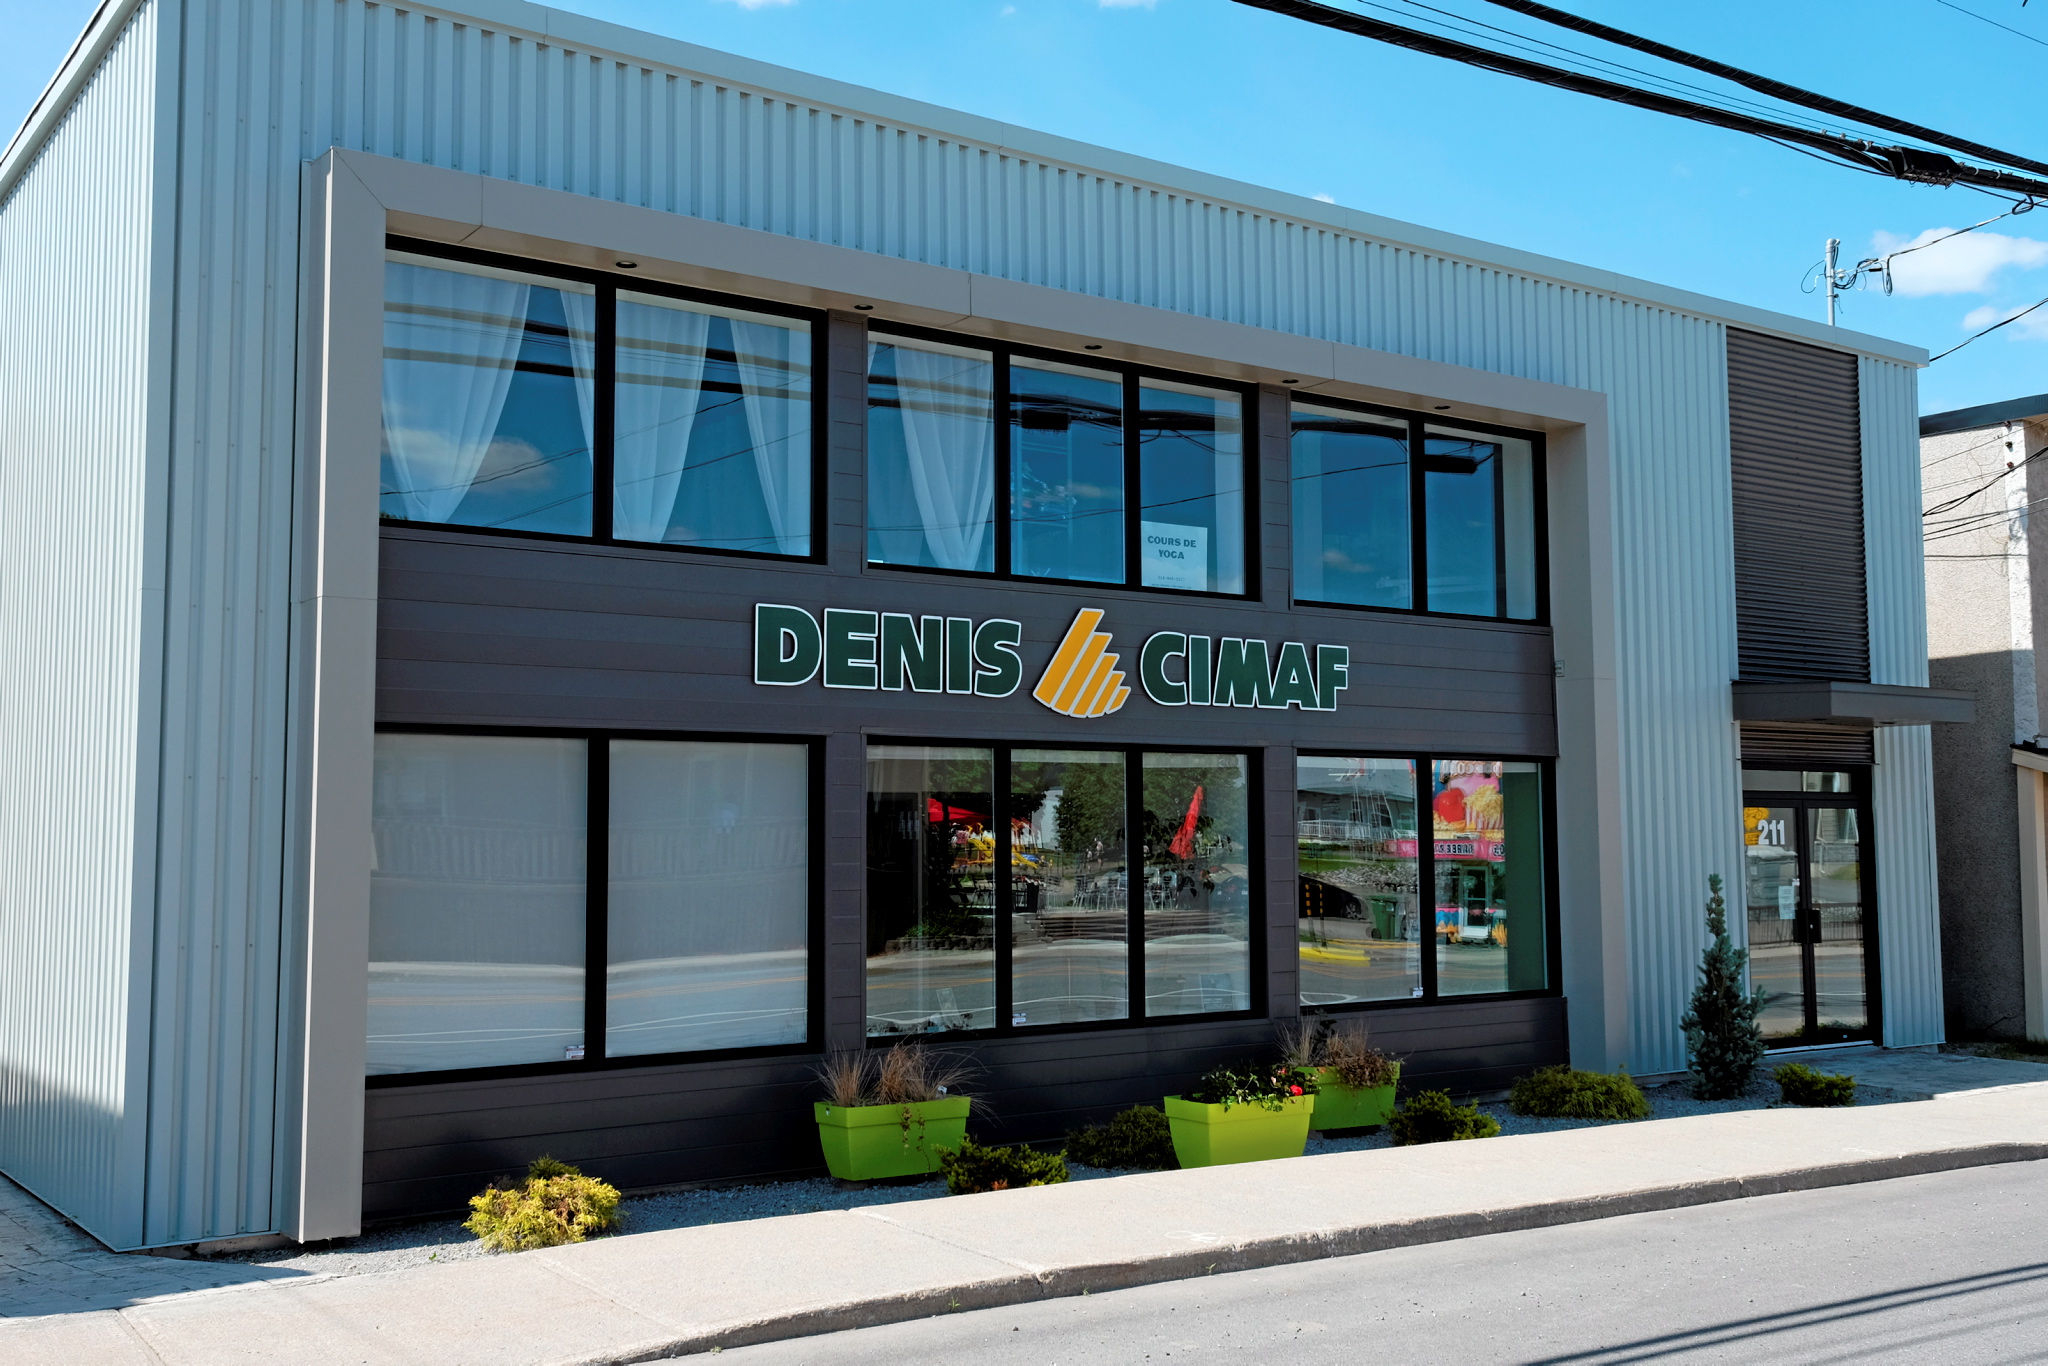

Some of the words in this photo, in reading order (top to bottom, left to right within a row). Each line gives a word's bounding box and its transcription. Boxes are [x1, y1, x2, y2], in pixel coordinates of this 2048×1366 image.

[1147, 535, 1181, 547] COURS
[1183, 539, 1197, 548] DE
[1158, 549, 1185, 560] YOGA
[754, 602, 1023, 698] DENIS
[1140, 631, 1349, 711] CIMAF
[1757, 819, 1785, 845] 211
